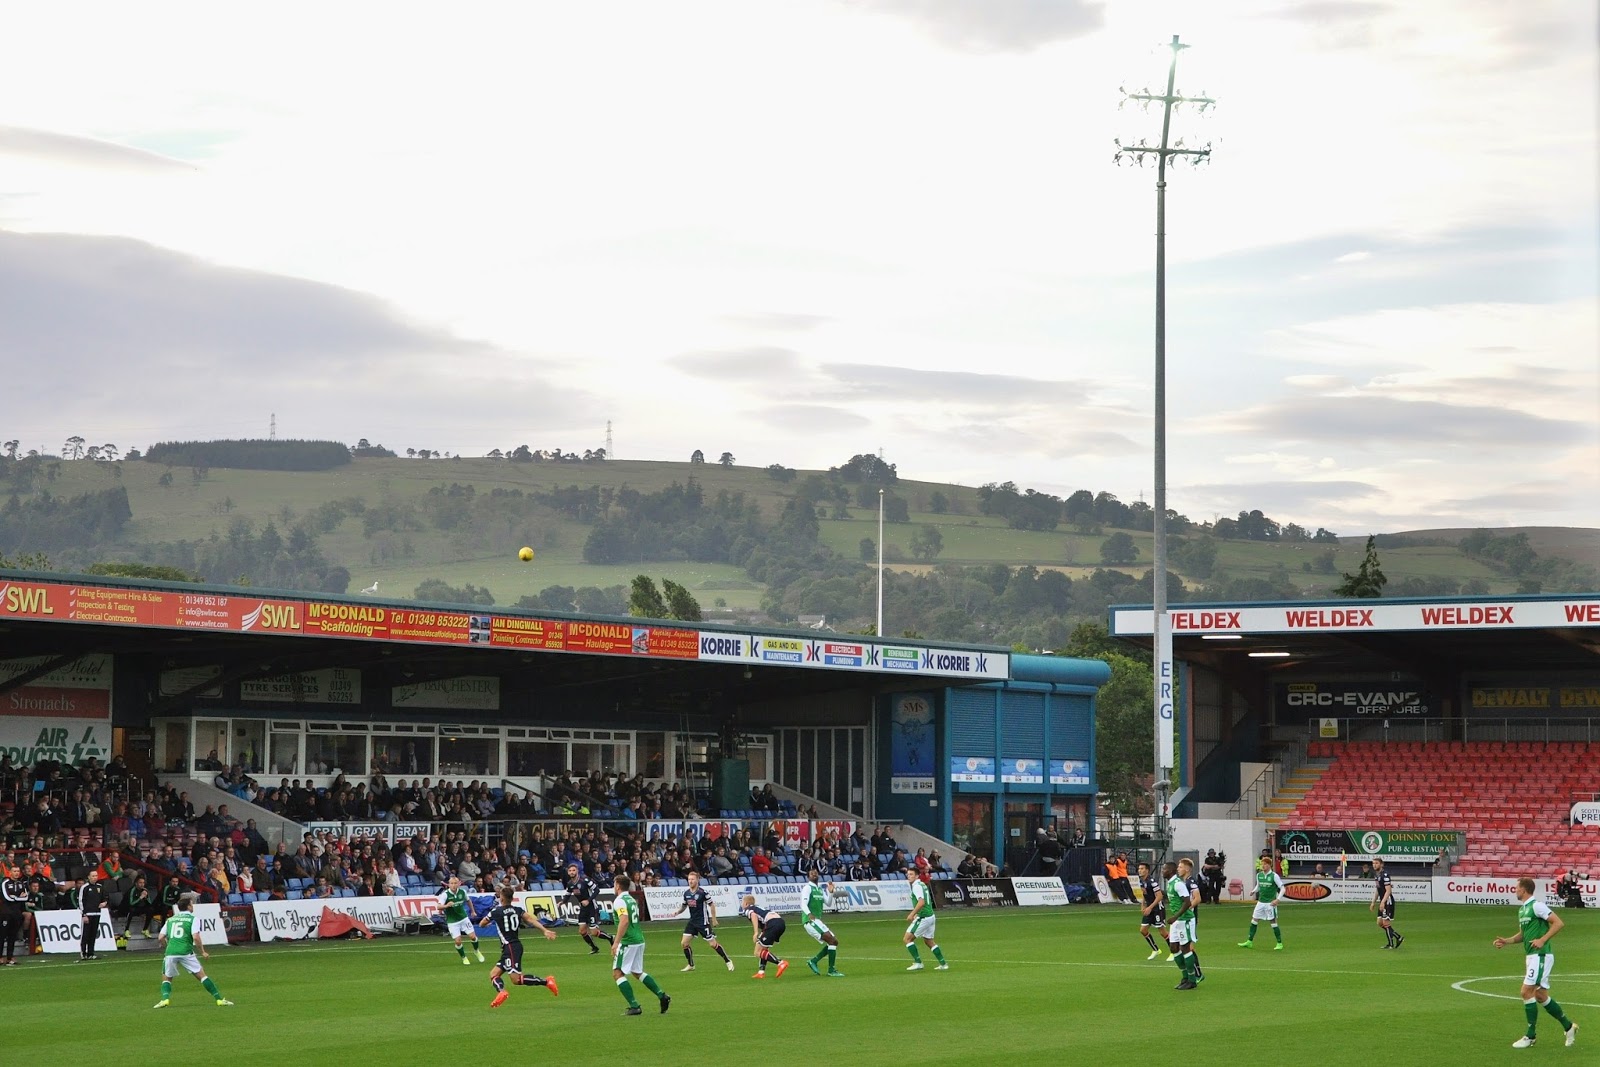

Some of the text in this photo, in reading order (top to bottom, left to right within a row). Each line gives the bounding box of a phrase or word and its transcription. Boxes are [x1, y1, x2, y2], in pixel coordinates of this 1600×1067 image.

[7, 586, 53, 614] SWL
[77, 588, 162, 602] Lifting Equipment Hire & Sales
[185, 596, 203, 604] 01349
[204, 597, 215, 606] 852
[76, 600, 135, 613] Inspection & Testing
[76, 611, 137, 623] Electrical Contractors
[261, 604, 300, 630] SWL
[391, 612, 469, 628] Tel. 01349 853222
[1286, 609, 1374, 628] WELDEX
[1421, 606, 1514, 625] WELDEX
[320, 620, 374, 637] Scaffolding
[492, 618, 543, 631] IAN DINGWALL
[492, 634, 543, 645] Painting Contractor
[585, 640, 614, 651] Haulage
[767, 640, 777, 648] GAS
[779, 641, 789, 649] AND
[701, 637, 741, 657] KORRIE
[831, 645, 856, 655] ELECTRICAL
[766, 652, 799, 662] MAINTENANCE
[832, 657, 854, 665] PLUMBING
[937, 655, 970, 671] KORRIE
[886, 660, 914, 669] MECHANICAL
[243, 682, 268, 692] TYRE
[10, 692, 76, 711] Stronachs
[1287, 692, 1420, 706] CRC-EVANS
[903, 702, 923, 713] SMS
[35, 727, 69, 747] AIR
[355, 826, 387, 837] GRAY
[1387, 834, 1428, 843] JOHNNY
[1289, 841, 1311, 853] den
[766, 886, 797, 894] ALEXANDER
[1285, 885, 1324, 897] MACKAY
[1447, 881, 1517, 893] Corrie Moto
[1545, 883, 1596, 894] ISZU
[845, 886, 881, 906] NTS
[1465, 895, 1510, 905] Inverness
[660, 903, 676, 911] Toyota
[259, 911, 286, 931] The
[503, 914, 519, 932] 10
[39, 922, 113, 942] macn
[170, 922, 184, 938] 16
[1528, 968, 1535, 978] 3
